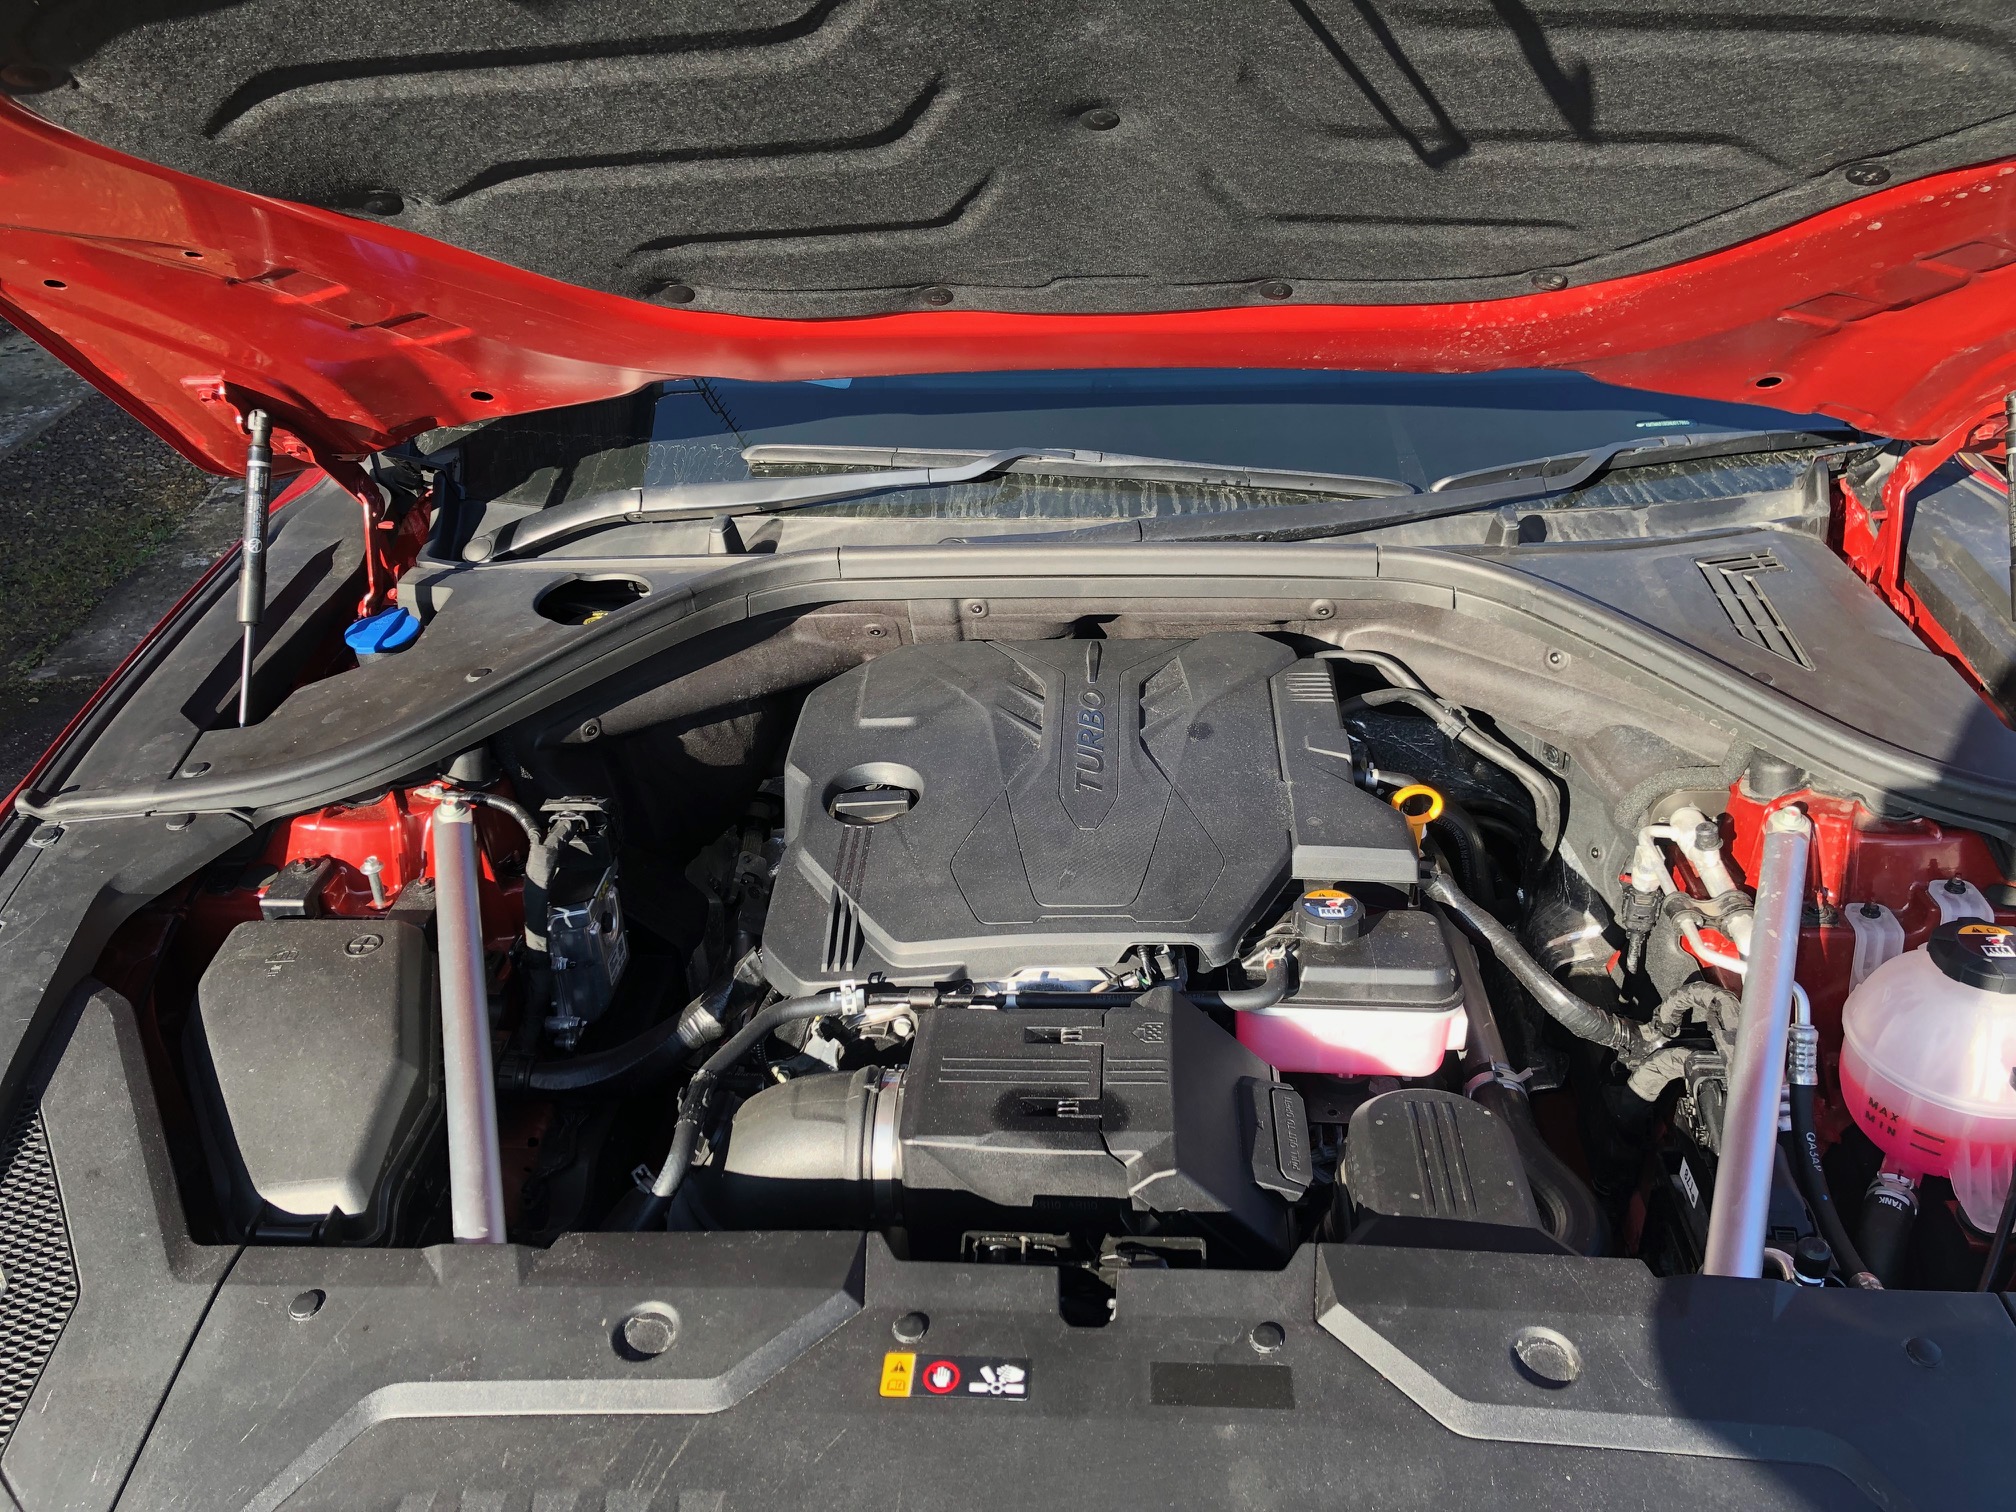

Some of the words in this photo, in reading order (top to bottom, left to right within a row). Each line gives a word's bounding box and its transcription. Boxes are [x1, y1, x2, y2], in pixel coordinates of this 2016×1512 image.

[1074, 689, 1106, 791] TURBO
[1868, 1097, 1899, 1123] MAX
[1865, 1110, 1896, 1137] MIN
[1878, 1196, 1902, 1211] TANK
